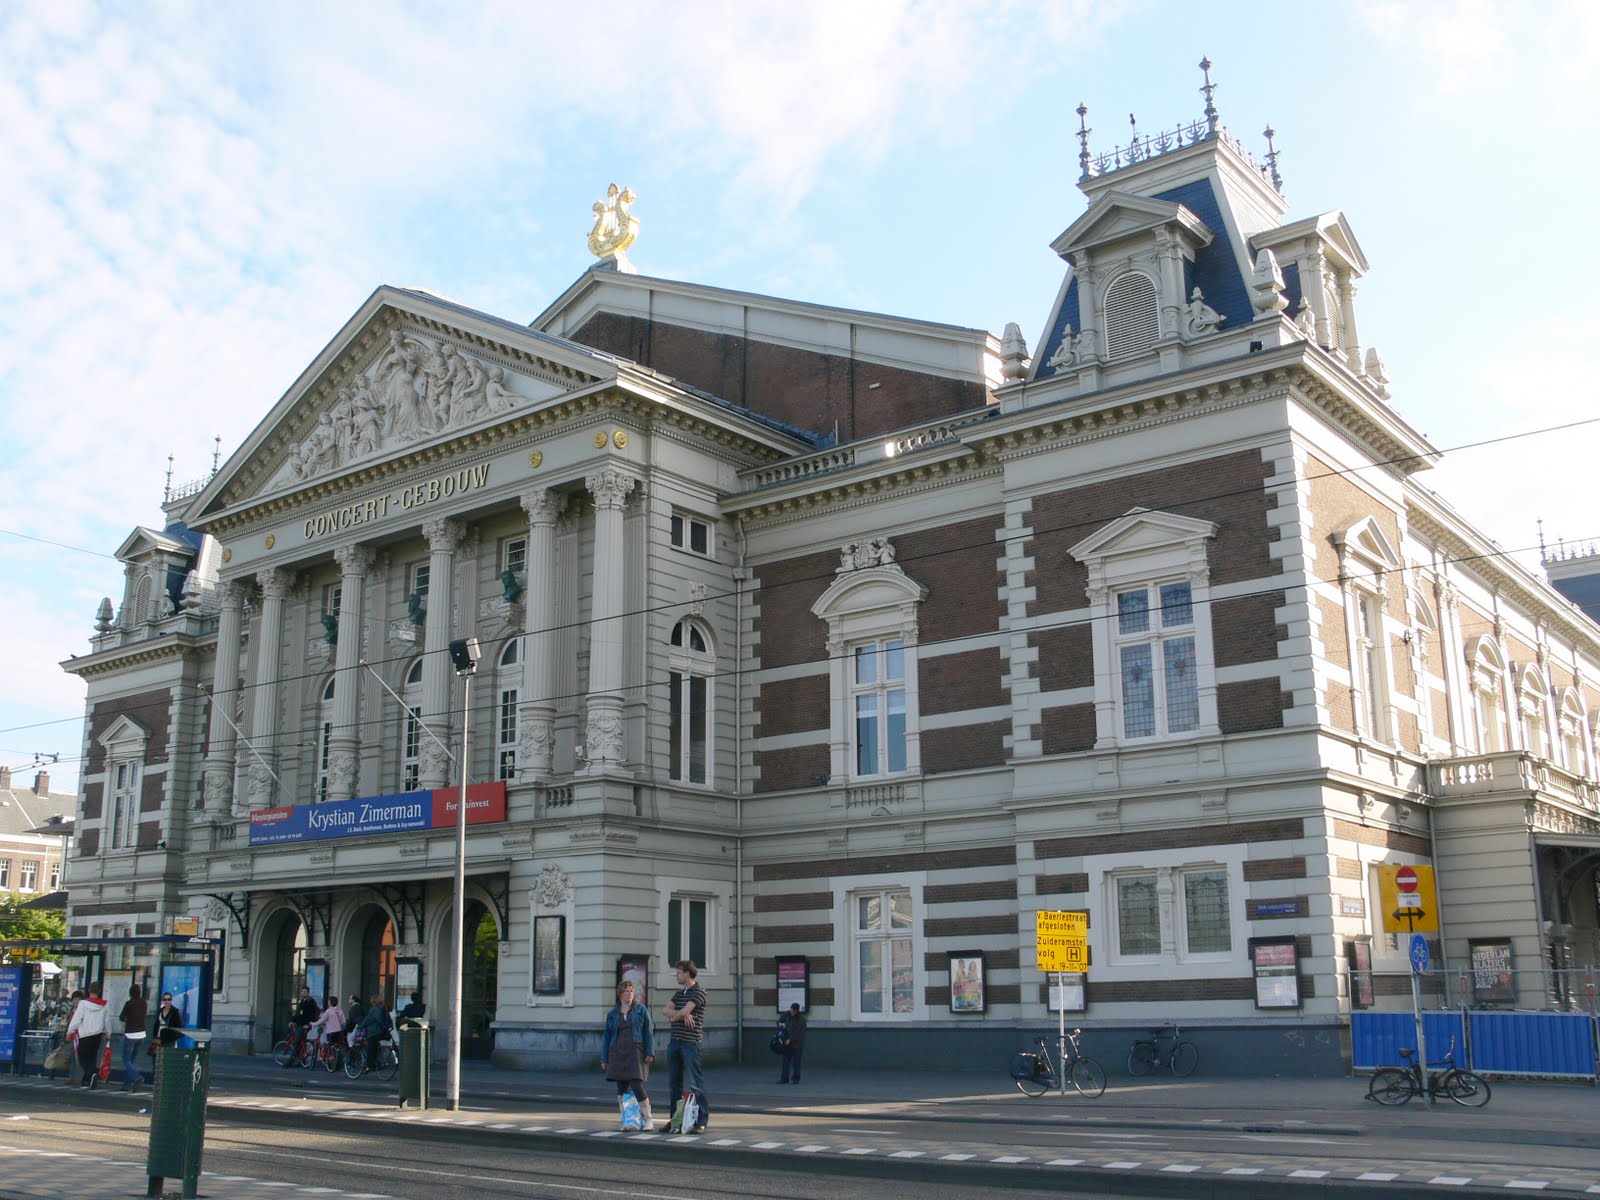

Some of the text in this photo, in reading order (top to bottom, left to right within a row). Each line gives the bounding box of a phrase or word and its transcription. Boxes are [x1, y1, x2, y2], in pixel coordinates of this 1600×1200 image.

[308, 803, 422, 831] Krystian Zimerman
[1044, 911, 1087, 922] Baerlestraat
[1038, 921, 1076, 932] afgesloten
[1037, 936, 1086, 947] Zuideramstel
[1037, 949, 1055, 959] volg
[1473, 959, 1506, 969] BLAZERS
